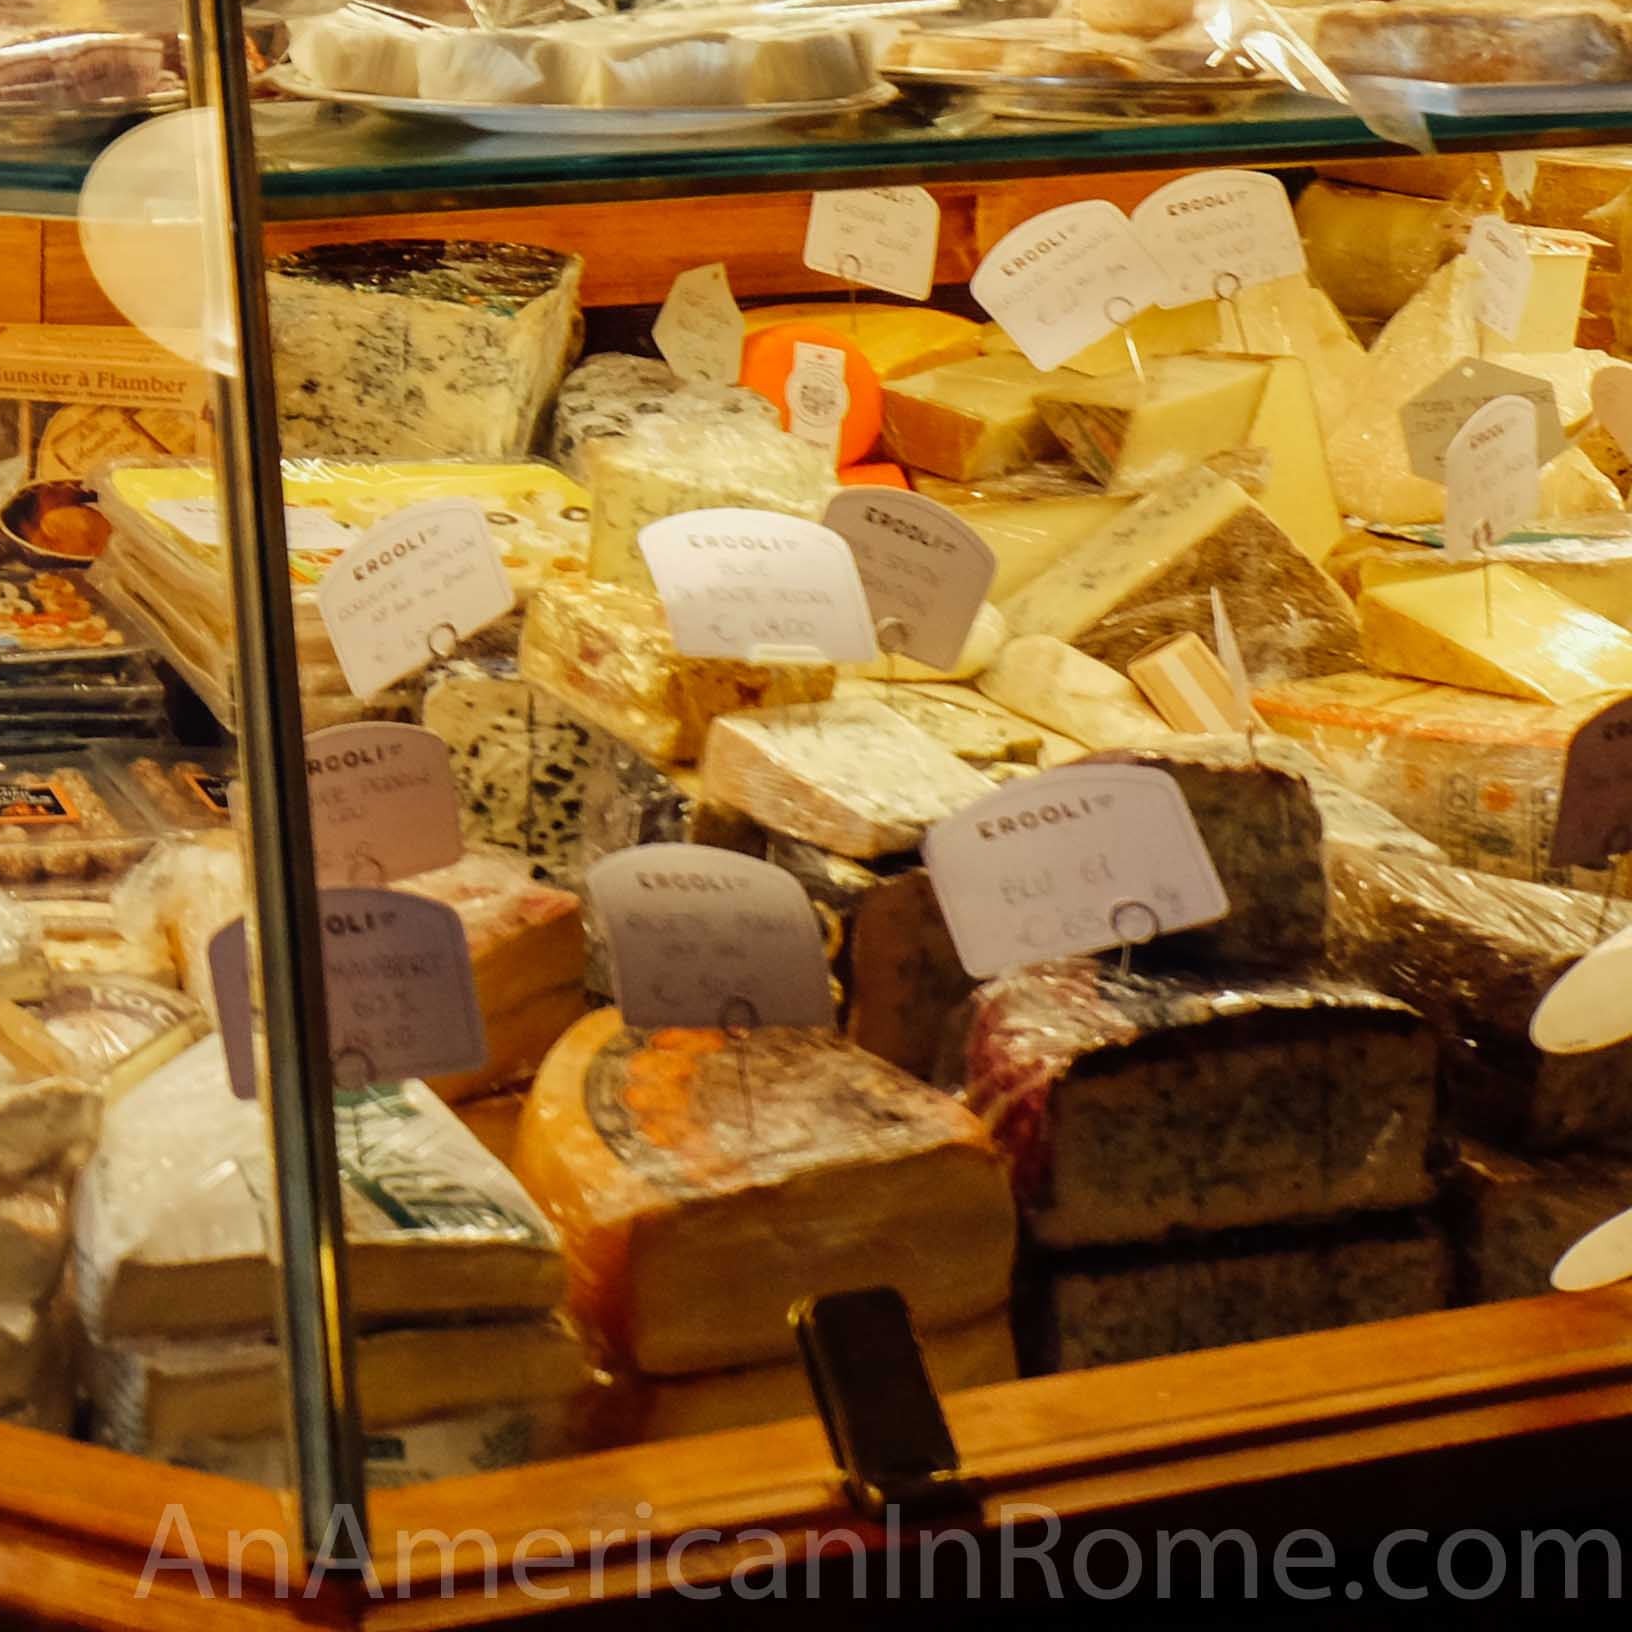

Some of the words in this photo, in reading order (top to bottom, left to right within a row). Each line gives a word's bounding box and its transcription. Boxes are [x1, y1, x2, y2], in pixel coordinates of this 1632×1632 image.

[1166, 191, 1242, 218] ERCOLI
[1001, 228, 1071, 278] ERCOLI
[76, 369, 91, 387] à
[96, 370, 188, 395] Flamber
[352, 530, 428, 582] ERCOLI
[688, 533, 782, 552] ERCOLI
[307, 745, 385, 777] RCOLI
[976, 794, 1095, 843] ERCOLI
[637, 871, 734, 893] ERCOLI
